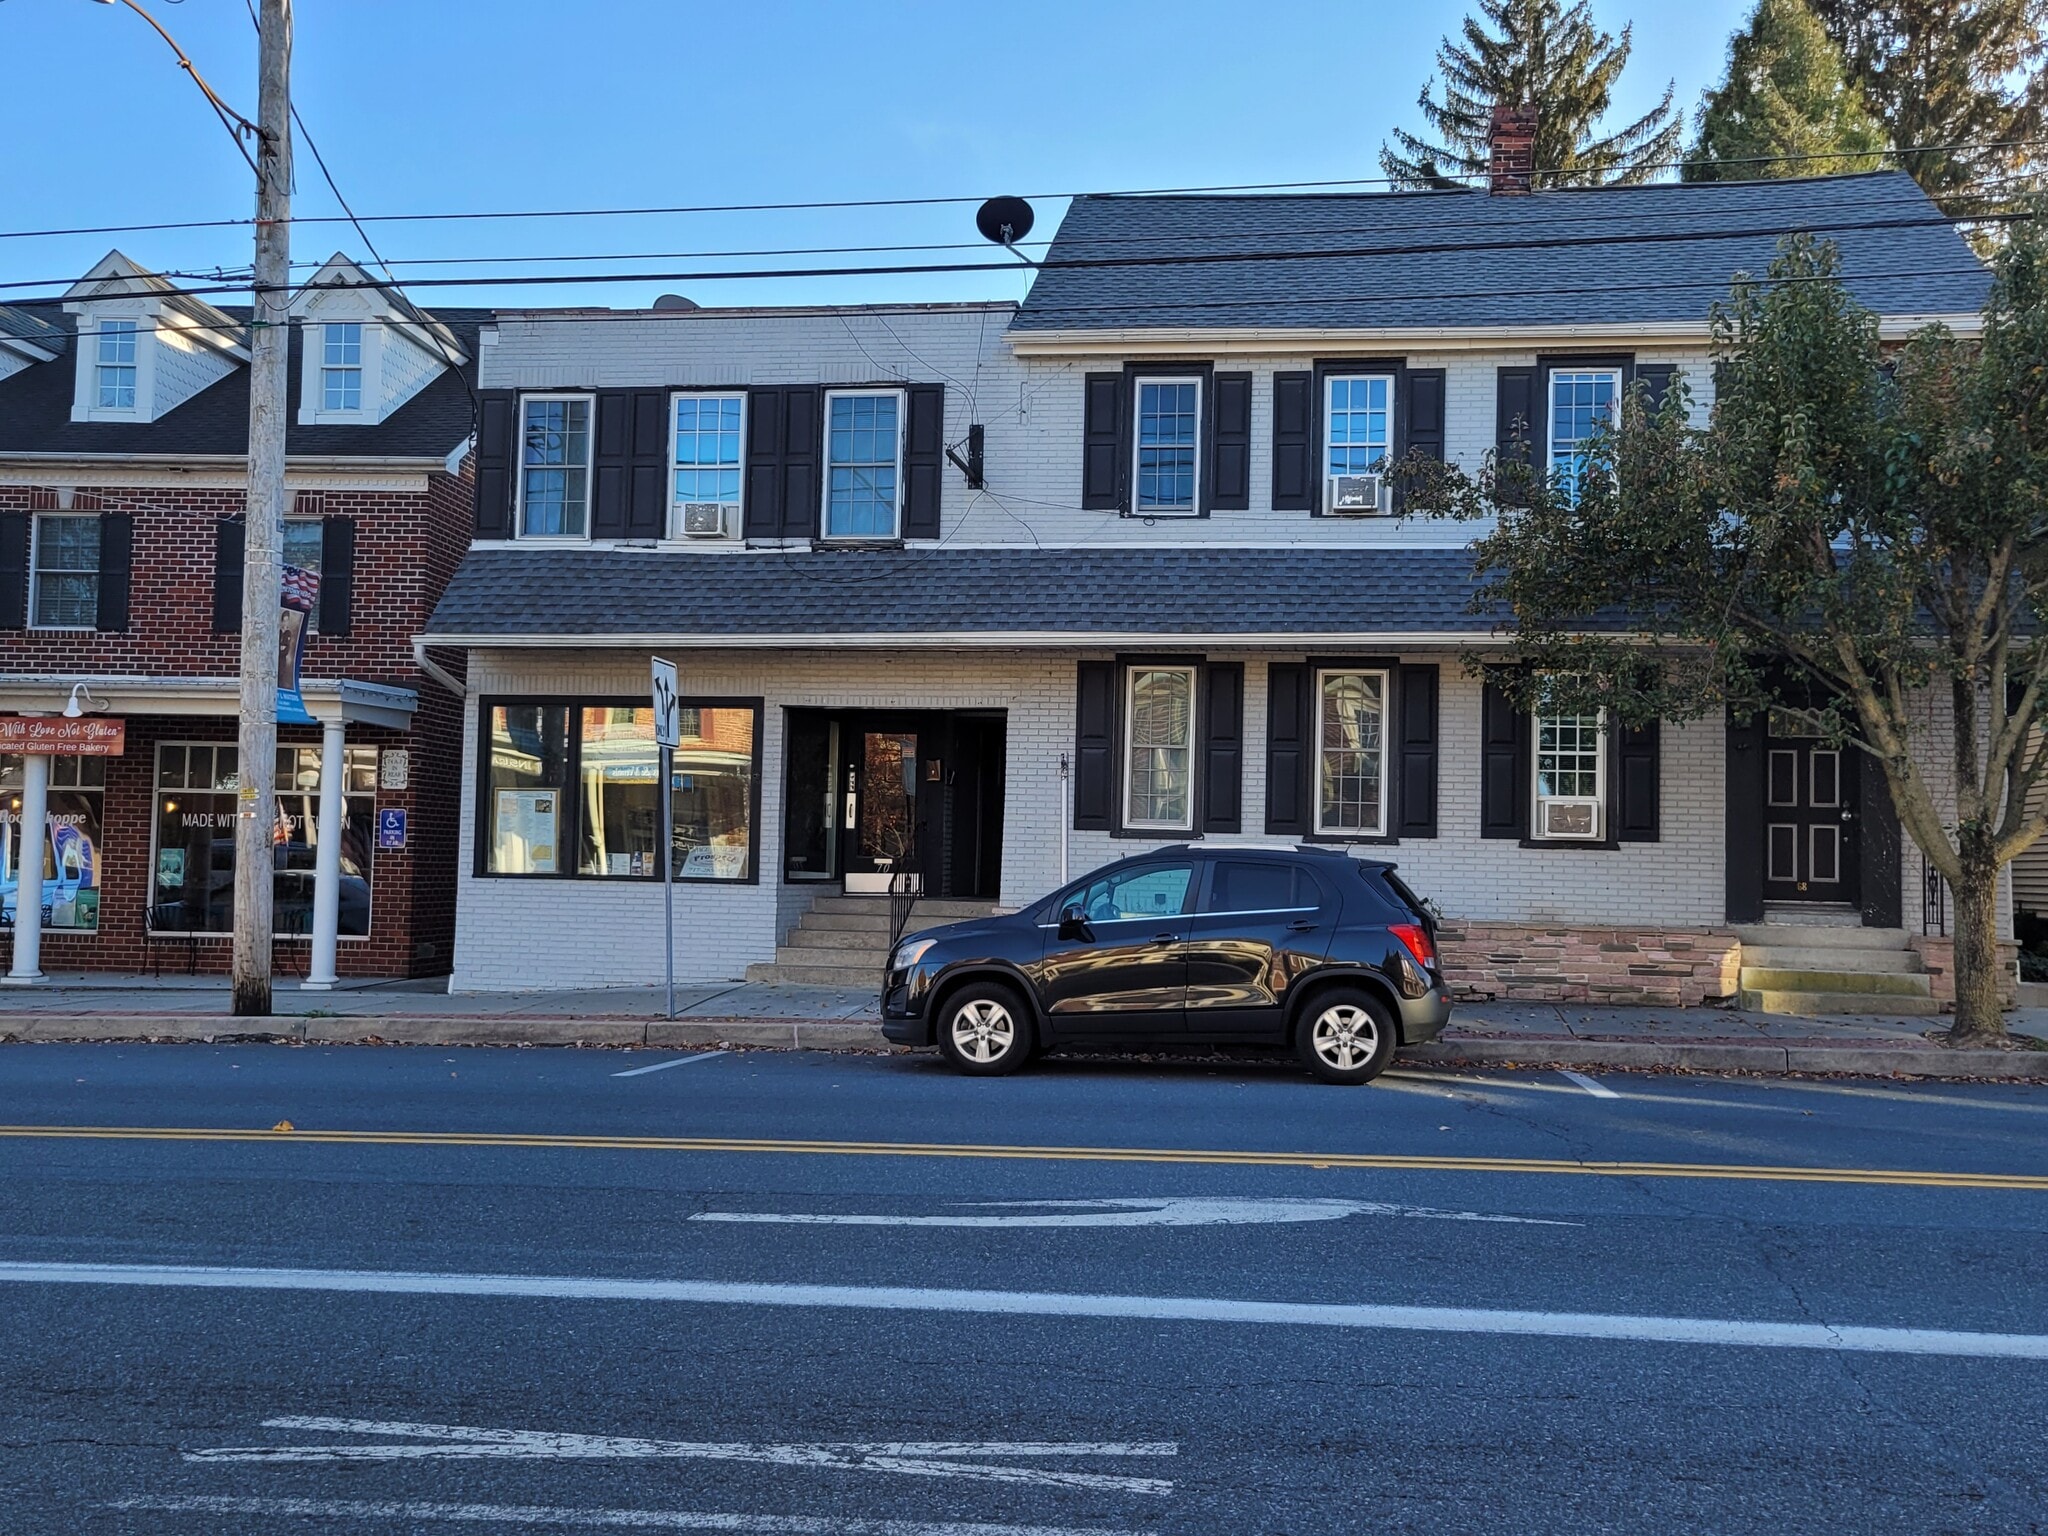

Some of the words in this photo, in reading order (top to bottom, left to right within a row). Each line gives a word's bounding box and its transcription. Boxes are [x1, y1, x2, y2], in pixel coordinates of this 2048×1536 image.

[29, 722, 55, 737] Love
[58, 722, 80, 738] Not
[0, 741, 25, 751] cated
[26, 742, 55, 751] Gluten
[57, 742, 77, 751] Free
[79, 743, 110, 753] Bakery
[45, 810, 86, 826] hoppe
[182, 813, 214, 828] MADE
[217, 813, 239, 828] WIT
[876, 863, 890, 873] 70
